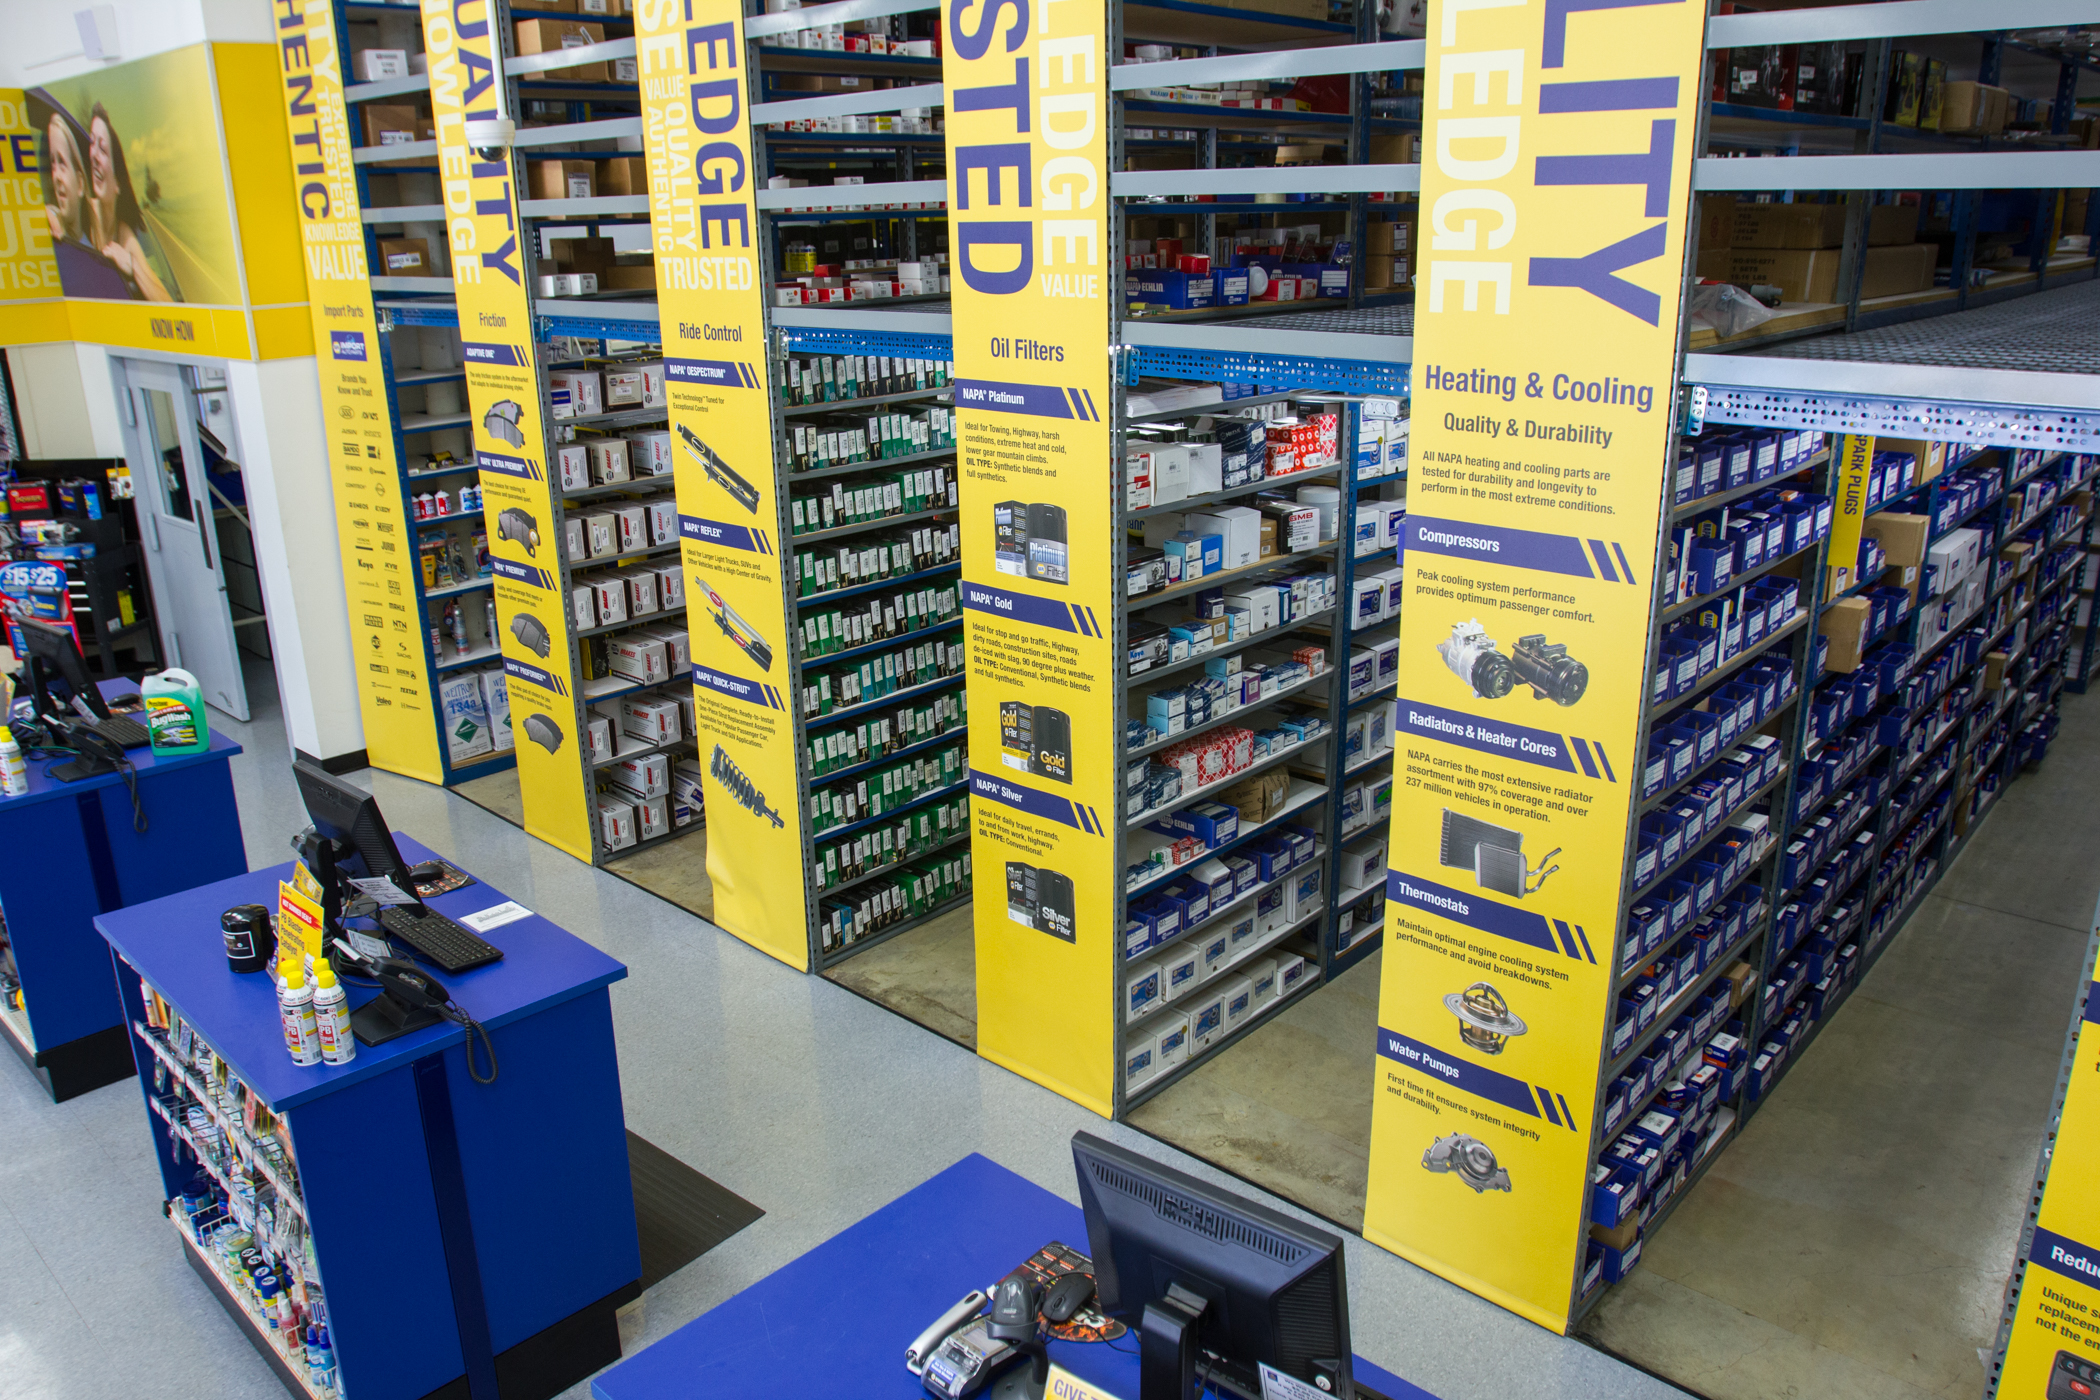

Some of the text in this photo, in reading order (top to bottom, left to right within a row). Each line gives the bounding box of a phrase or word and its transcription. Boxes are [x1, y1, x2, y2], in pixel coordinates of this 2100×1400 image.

[644, 75, 685, 101] VALUE
[317, 86, 344, 218] TRUSTED
[330, 92, 357, 218] EXPERTISE
[648, 106, 674, 252] AUTHENTIC
[665, 102, 697, 252] QUALITY
[305, 222, 360, 242] KNOWLEDGE
[306, 245, 366, 280] VALUE
[660, 257, 752, 290] TRUSTED
[1041, 274, 1098, 298] VALUE
[1142, 283, 1164, 292] ECHLIN
[324, 304, 364, 319] Import Parts
[479, 313, 506, 328] Friction
[150, 318, 194, 341] KNOW HOW
[679, 323, 742, 342] Ride Control
[340, 342, 364, 350] IMPORT
[991, 337, 1064, 362] Oil Filters
[989, 390, 1024, 404] Platinum
[1425, 365, 1654, 413] Heating & Cooling
[965, 422, 1060, 440] Ideal for Towing, Highway, harsh
[1444, 413, 1612, 449] Quality & Durability
[966, 435, 1066, 455] conditions, extreme heat and cold,
[966, 446, 1048, 464] lower gear mountain climbs.
[966, 458, 1056, 477] OIL TYPE: Synthetic blends and
[1423, 451, 1611, 481] All NAPA heating and cooling parts are
[1422, 467, 1597, 496] tested for durability and longevity to
[1422, 483, 1615, 515] perform in the most extreme conditions.
[1844, 475, 1862, 515] PLUGS
[1289, 512, 1313, 522] GMB
[1419, 527, 1500, 552] Compressors
[1030, 542, 1065, 567] Platinum
[5, 567, 57, 585] $15 $25
[1047, 566, 1065, 578] Filter
[995, 597, 1012, 610] Gold
[1130, 650, 1145, 659] Koyo
[151, 712, 191, 728] BugWash
[1002, 710, 1017, 727] Gold
[1410, 711, 1557, 757] Radiators & Heater Cores
[1040, 751, 1065, 768] Gold
[1002, 787, 1022, 803] Silver
[979, 808, 992, 818] Ideal
[1002, 815, 1015, 828] daily
[1016, 820, 1034, 834] travel,
[1035, 828, 1060, 842] errands,
[1174, 818, 1195, 833] ECHLIN
[1399, 882, 1469, 915] Thermostats
[1042, 907, 1070, 927] Silver
[1056, 924, 1071, 936] Filter
[1397, 918, 1569, 981] Maintain optimal engine cooling system
[1389, 1039, 1459, 1078] Water Pumps
[2042, 1286, 2088, 1313] Unique
[2036, 1316, 2081, 1342] not the
[2038, 1302, 2100, 1335] replacem
